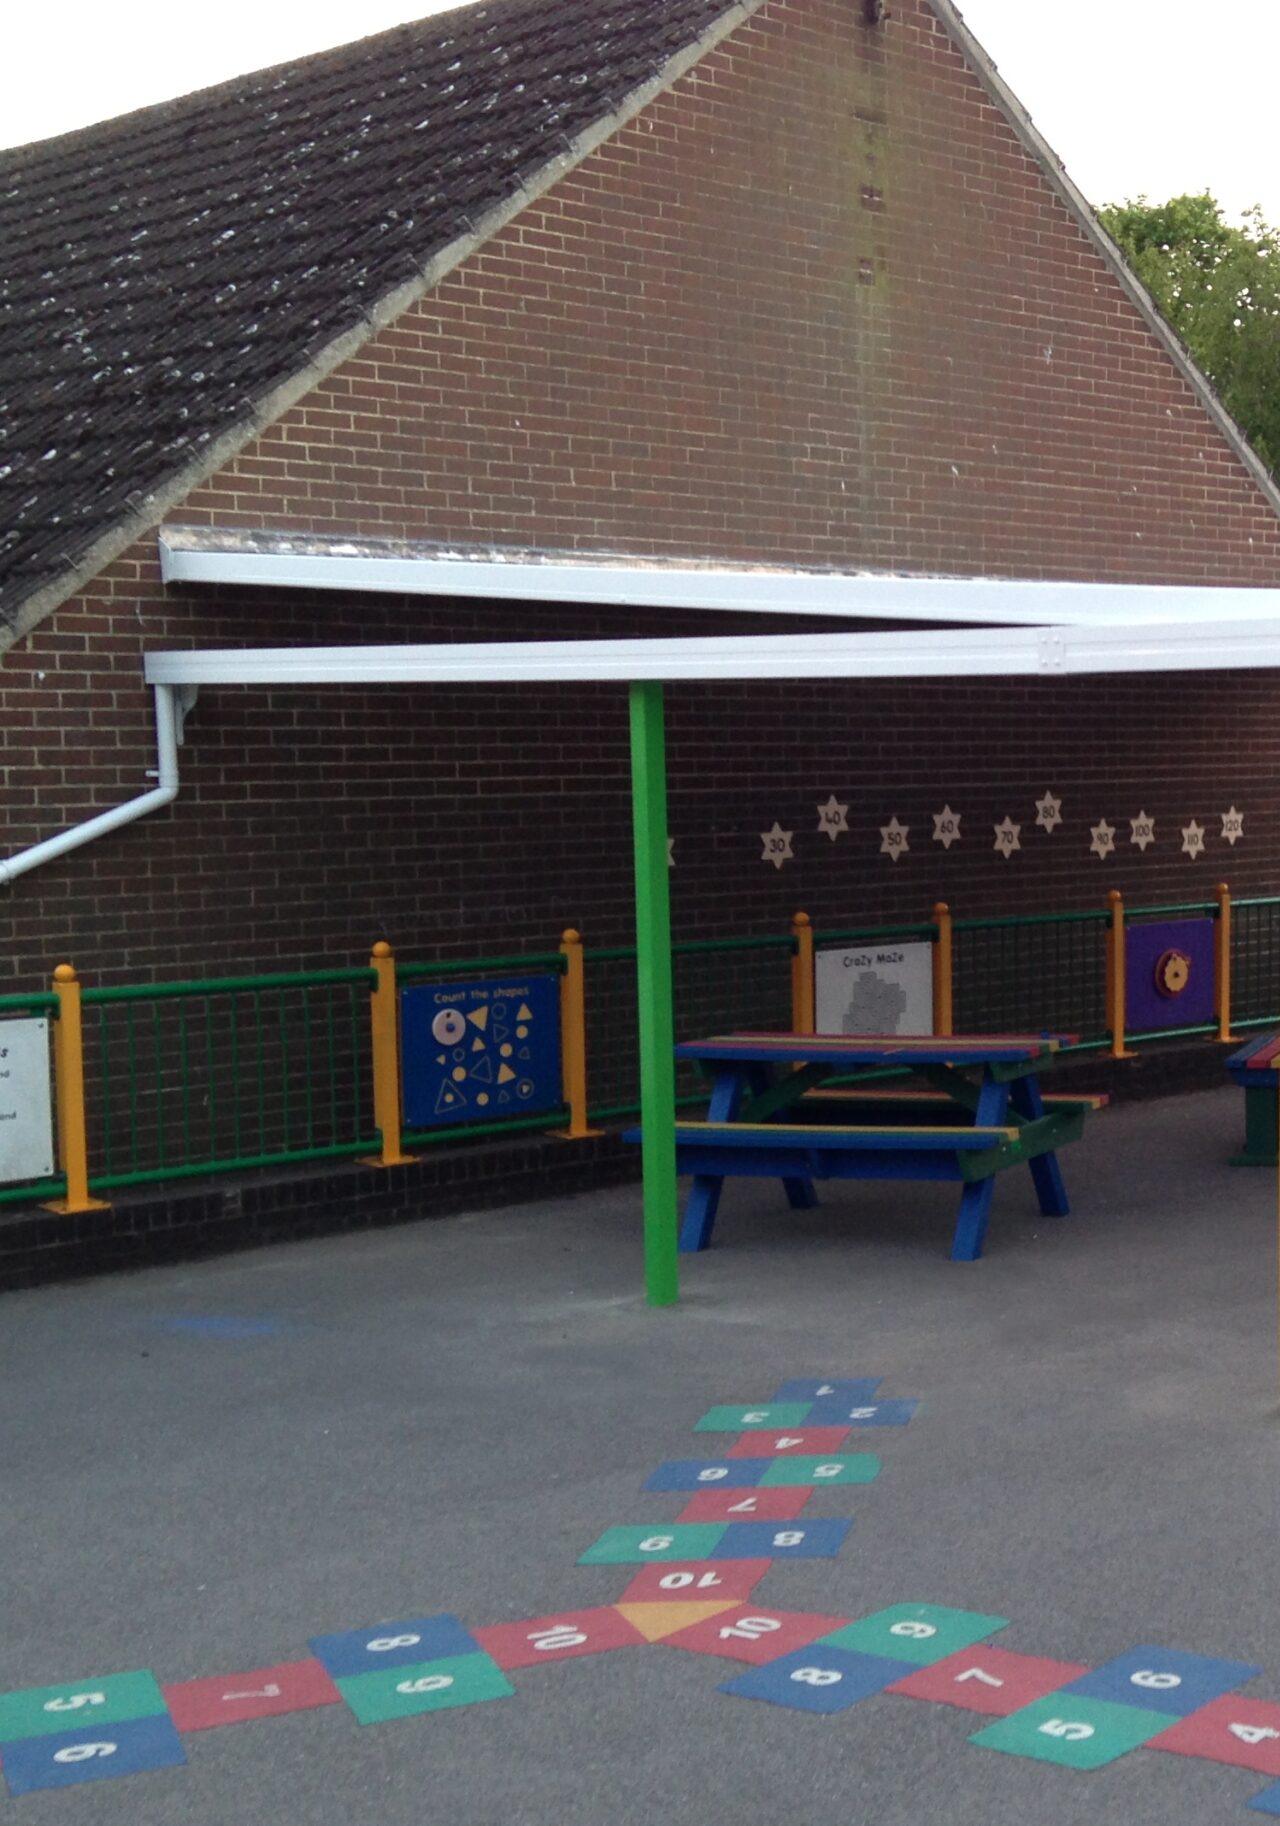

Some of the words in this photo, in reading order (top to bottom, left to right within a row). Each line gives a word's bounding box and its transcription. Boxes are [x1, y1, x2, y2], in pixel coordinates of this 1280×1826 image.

[825, 810, 841, 825] 40
[1042, 805, 1055, 819] 80
[940, 820, 954, 834] 60
[1135, 824, 1150, 837] 100
[1225, 820, 1239, 832] 120
[769, 838, 785, 852] 30
[887, 832, 902, 846] 50
[1001, 831, 1014, 844] 70
[1097, 833, 1109, 845] 90
[1187, 834, 1199, 845] 110
[434, 991, 466, 1004] Count
[471, 989, 489, 999] the
[774, 1436, 804, 1449] 4
[812, 1463, 845, 1478] 5
[727, 1497, 758, 1512] 7
[772, 1530, 805, 1547] 8
[658, 1571, 723, 1589] 10
[719, 1616, 782, 1640] 10
[366, 1633, 421, 1652] 8
[527, 1625, 588, 1650] 10
[790, 1667, 843, 1686] 8
[954, 1667, 1004, 1688] 7
[44, 1692, 107, 1712] 5
[1037, 1718, 1095, 1741] 5
[1227, 1722, 1280, 1744] 4
